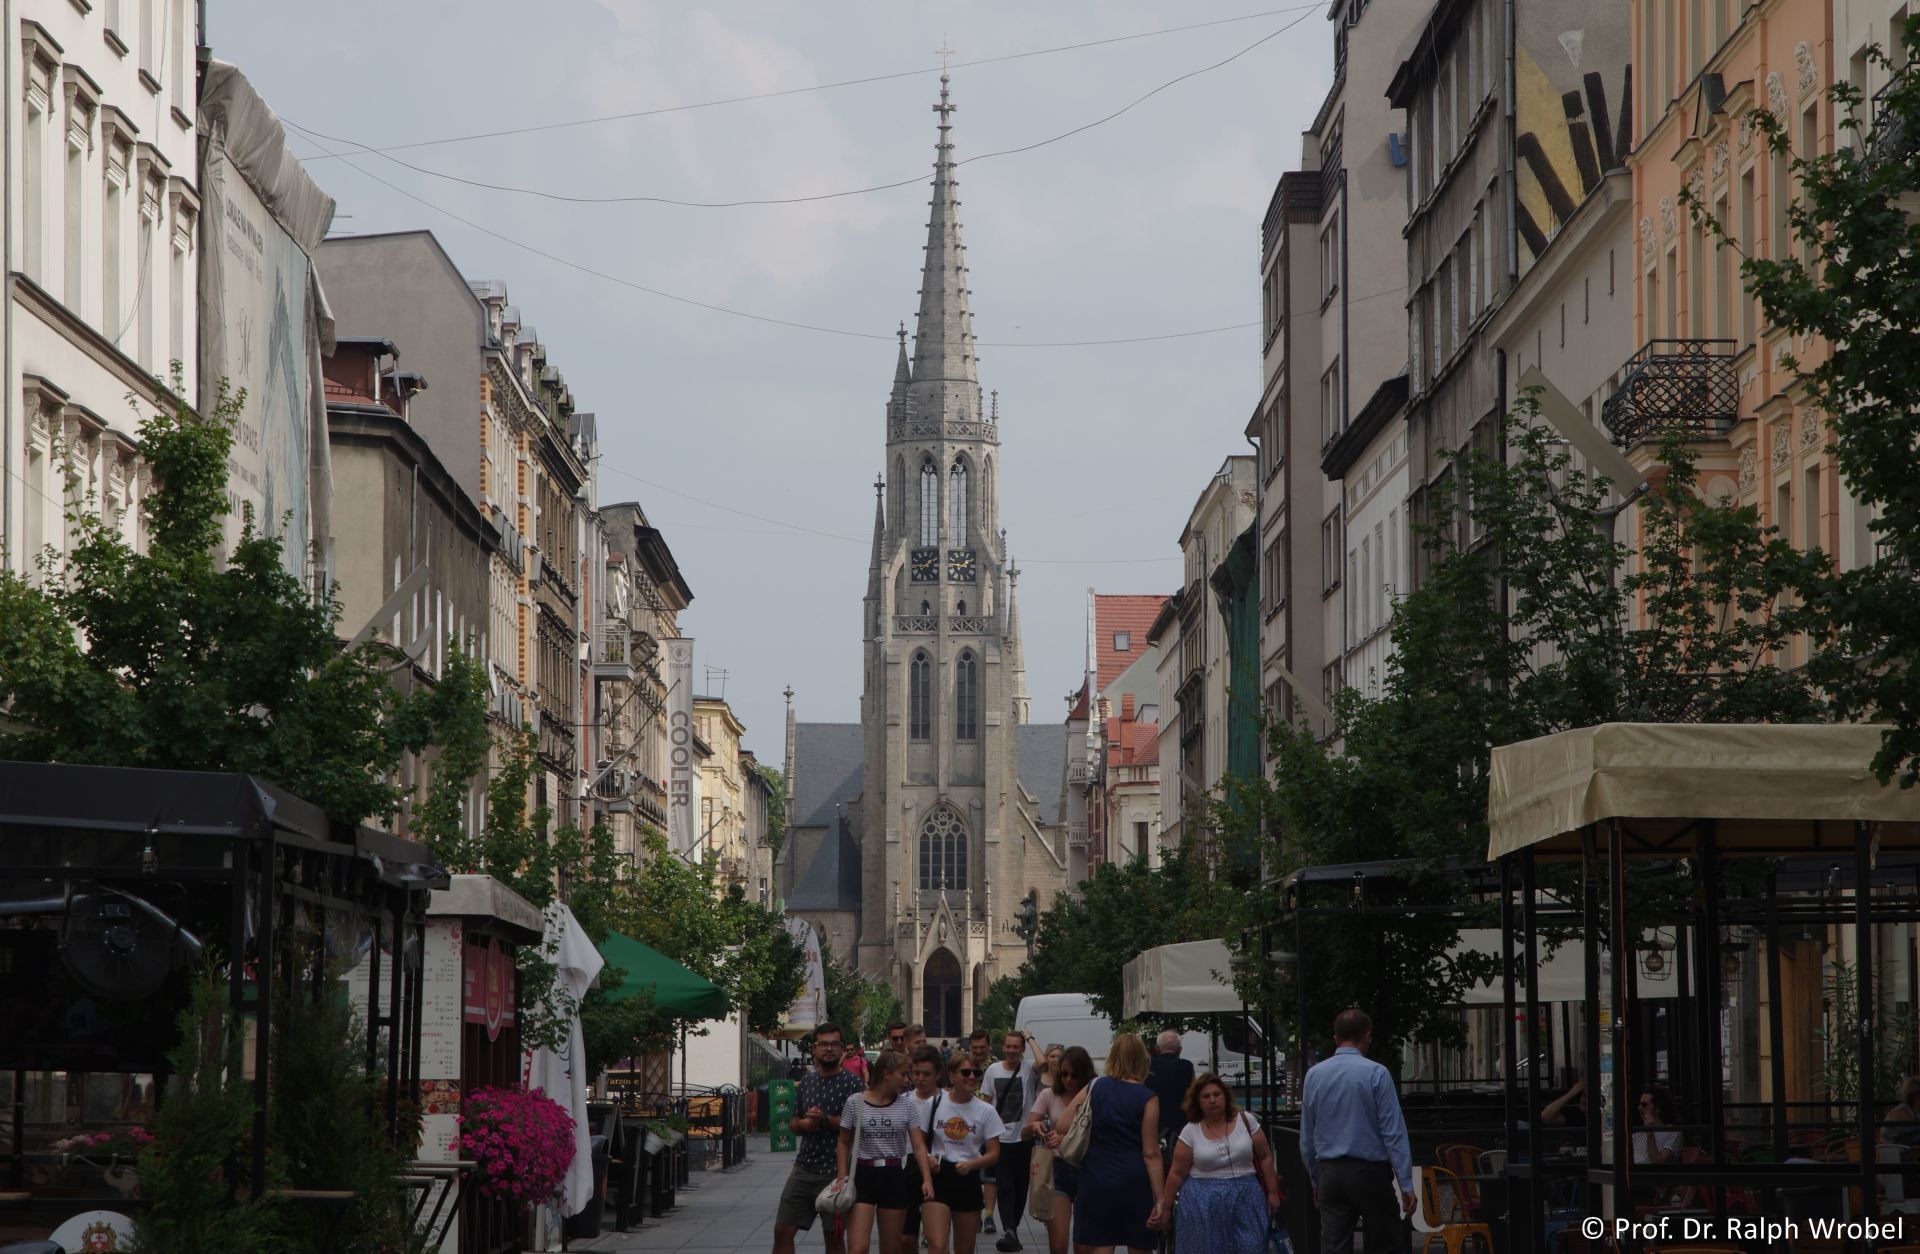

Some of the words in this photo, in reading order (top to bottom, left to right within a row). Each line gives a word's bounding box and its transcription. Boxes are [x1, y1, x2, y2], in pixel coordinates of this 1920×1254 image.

[670, 710, 689, 807] COOLER
[881, 1115, 892, 1126] la
[936, 1119, 957, 1131] Hard
